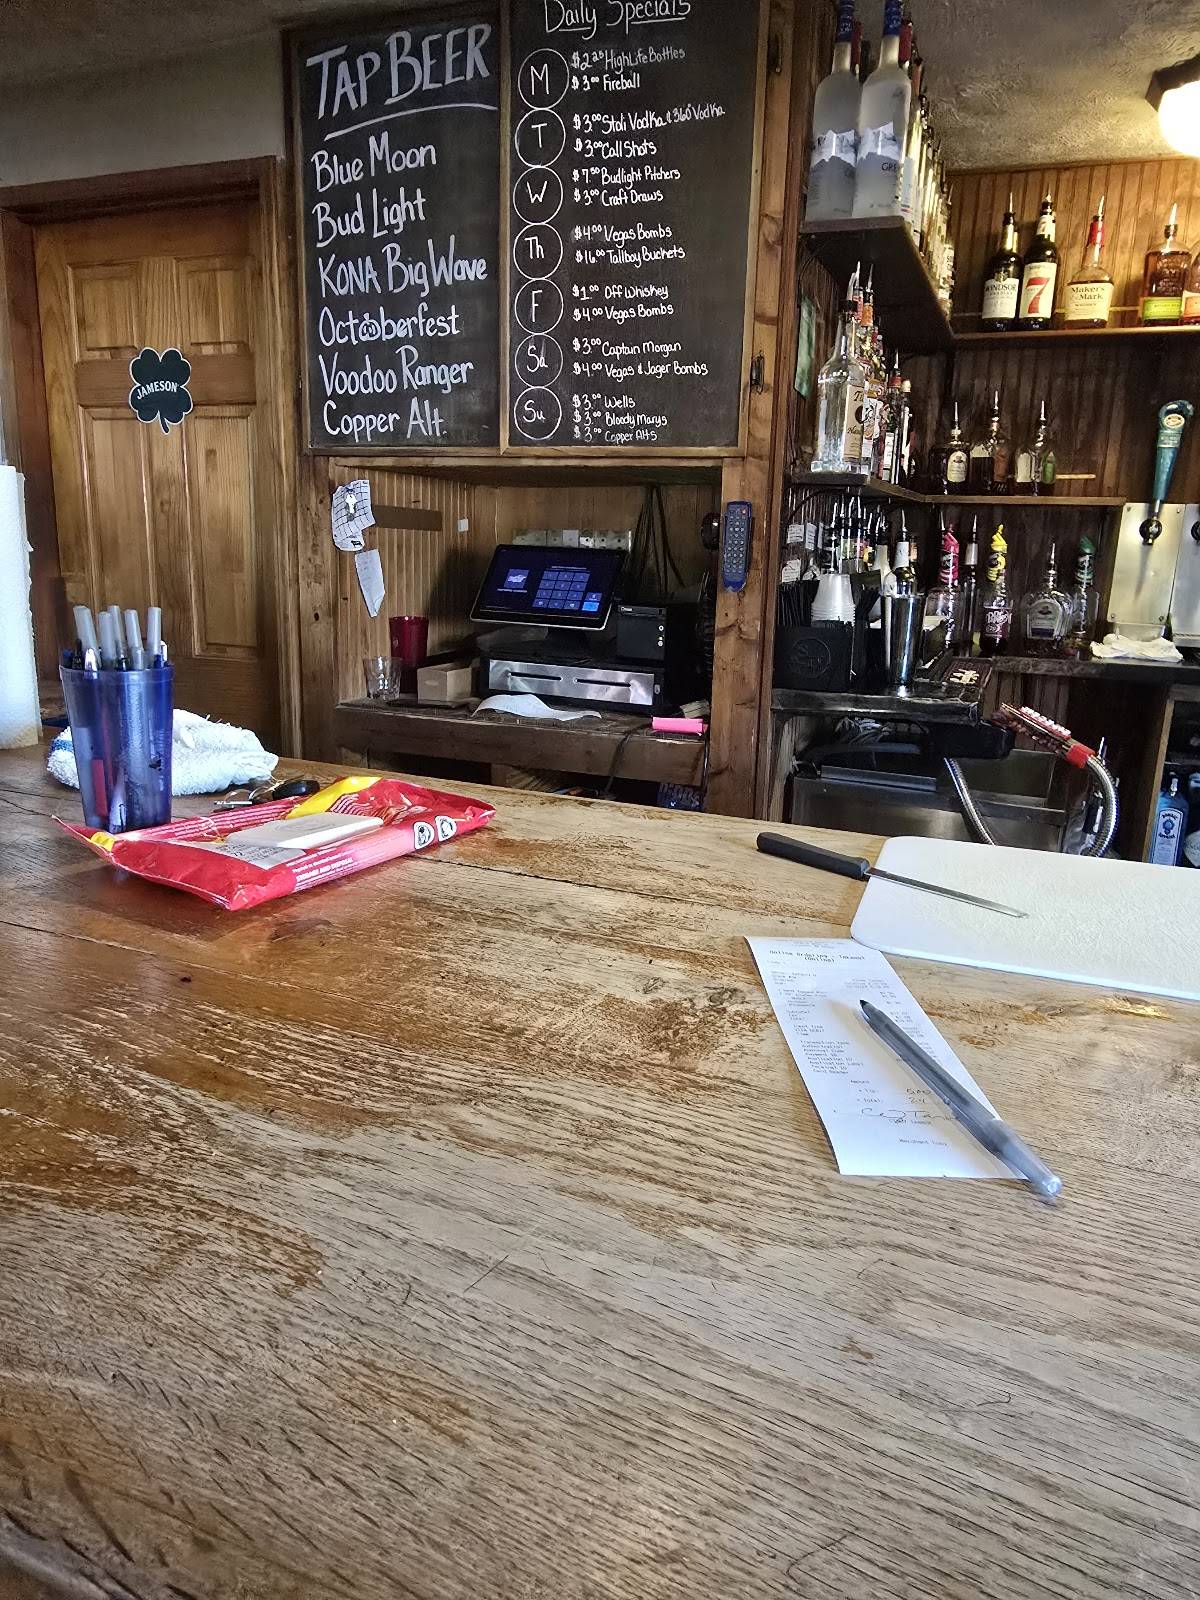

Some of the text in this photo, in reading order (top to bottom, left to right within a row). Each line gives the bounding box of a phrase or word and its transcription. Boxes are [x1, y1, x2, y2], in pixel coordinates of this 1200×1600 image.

[545, 0, 691, 40] Daily Specials
[648, 46, 686, 63] Bottles
[306, 23, 492, 119] TAP BEER
[530, 63, 550, 95] M
[603, 71, 640, 91] Fireball
[602, 111, 627, 134] Stoli
[531, 122, 548, 148] T
[601, 140, 623, 160] Call
[623, 138, 657, 158] Shots
[310, 130, 437, 193] Blue Moon
[644, 165, 681, 181] Pitchers
[526, 180, 548, 203] W
[601, 188, 628, 207] Craft
[629, 189, 664, 204] Draws
[311, 186, 427, 247] Bud Light
[603, 225, 636, 249] Vegas
[636, 222, 672, 241] Bombs
[524, 236, 545, 259] Th
[605, 249, 642, 268] Tallboy
[641, 244, 686, 262] Buckets
[318, 234, 489, 298] KONA Big Wave
[604, 284, 623, 300] Off
[624, 283, 669, 300] Whiskey
[1026, 276, 1050, 315] 7
[531, 289, 543, 322] F
[604, 305, 637, 325] Vegas
[637, 303, 674, 318] Bombs
[318, 302, 460, 347] Octoberfest
[601, 340, 641, 361] Captain
[642, 340, 682, 358] Morgan
[318, 344, 475, 398] Voodoo Ranger
[604, 363, 635, 382] Vegas
[643, 360, 672, 379] Jager
[673, 360, 709, 376] Bombs
[136, 380, 178, 400] JAMESON
[604, 394, 637, 409] Wells
[323, 396, 448, 443] Copper Alt.
[522, 399, 546, 423] Su
[604, 411, 636, 429] Bloody
[636, 413, 668, 428] Marys
[604, 430, 634, 445] Copper
